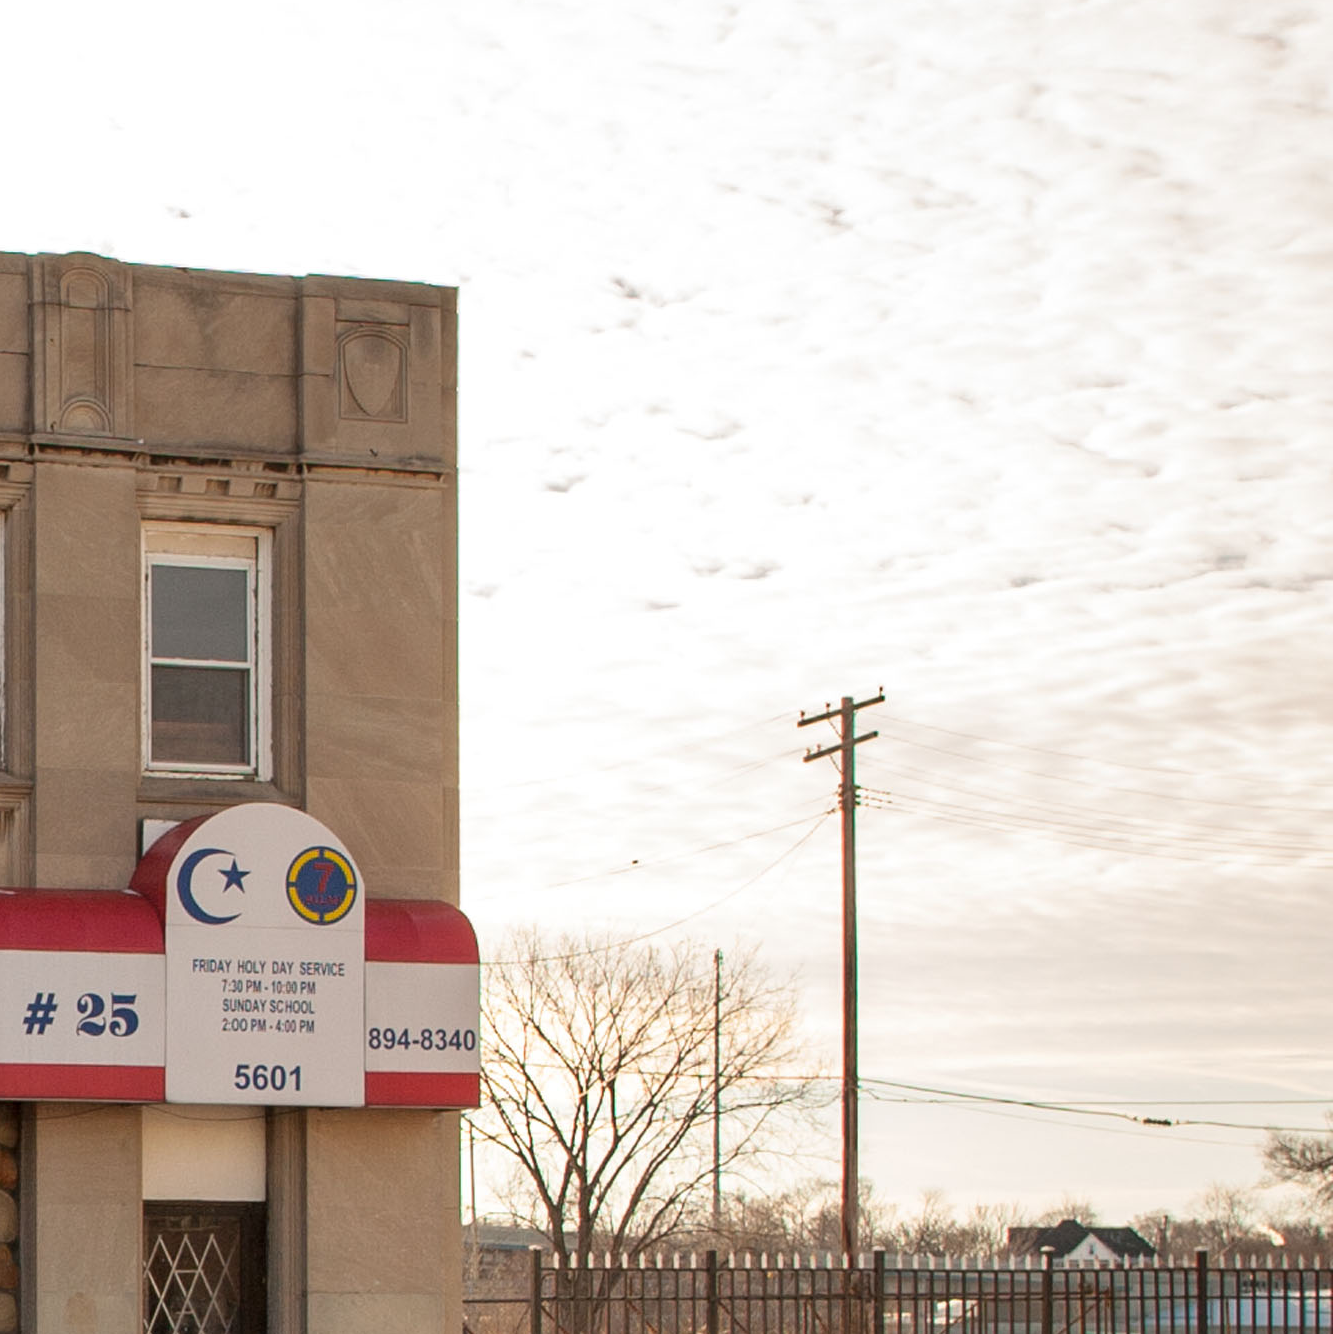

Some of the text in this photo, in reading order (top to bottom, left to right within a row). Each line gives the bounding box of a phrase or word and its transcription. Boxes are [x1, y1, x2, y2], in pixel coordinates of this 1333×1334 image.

[313, 862, 335, 894] 7
[192, 959, 345, 976] FRIDAY HOLY DAY SERVICE
[222, 979, 243, 993] 7:30
[246, 980, 262, 993] PM
[272, 981, 298, 994] 10:00
[300, 981, 316, 995] PM
[22, 992, 57, 1035] #
[76, 993, 140, 1037] 25
[222, 999, 315, 1015] SUNDAY SCHOOL
[222, 1018, 248, 1032] 2:00
[251, 1019, 267, 1032] PM
[275, 1020, 297, 1033] 4:00
[300, 1020, 315, 1033] PM
[368, 1028, 476, 1051] 894-8340
[234, 1065, 302, 1091] 5601
